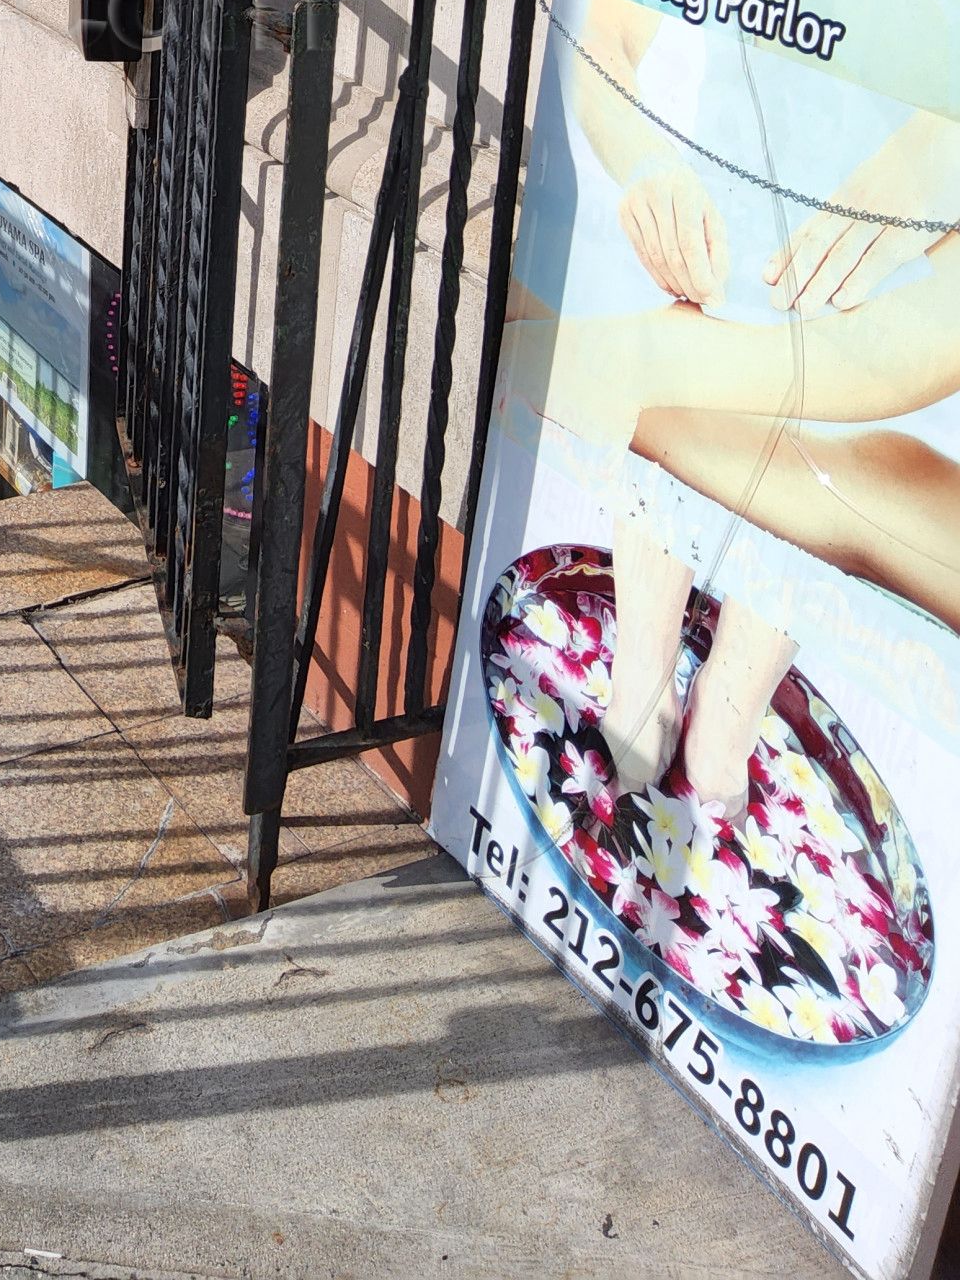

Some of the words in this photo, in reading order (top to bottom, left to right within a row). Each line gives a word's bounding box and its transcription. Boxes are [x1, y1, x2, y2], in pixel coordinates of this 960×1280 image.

[28, 239, 46, 266] SPA
[469, 805, 529, 904] Tel:
[542, 885, 858, 1243] 212-675-8801
